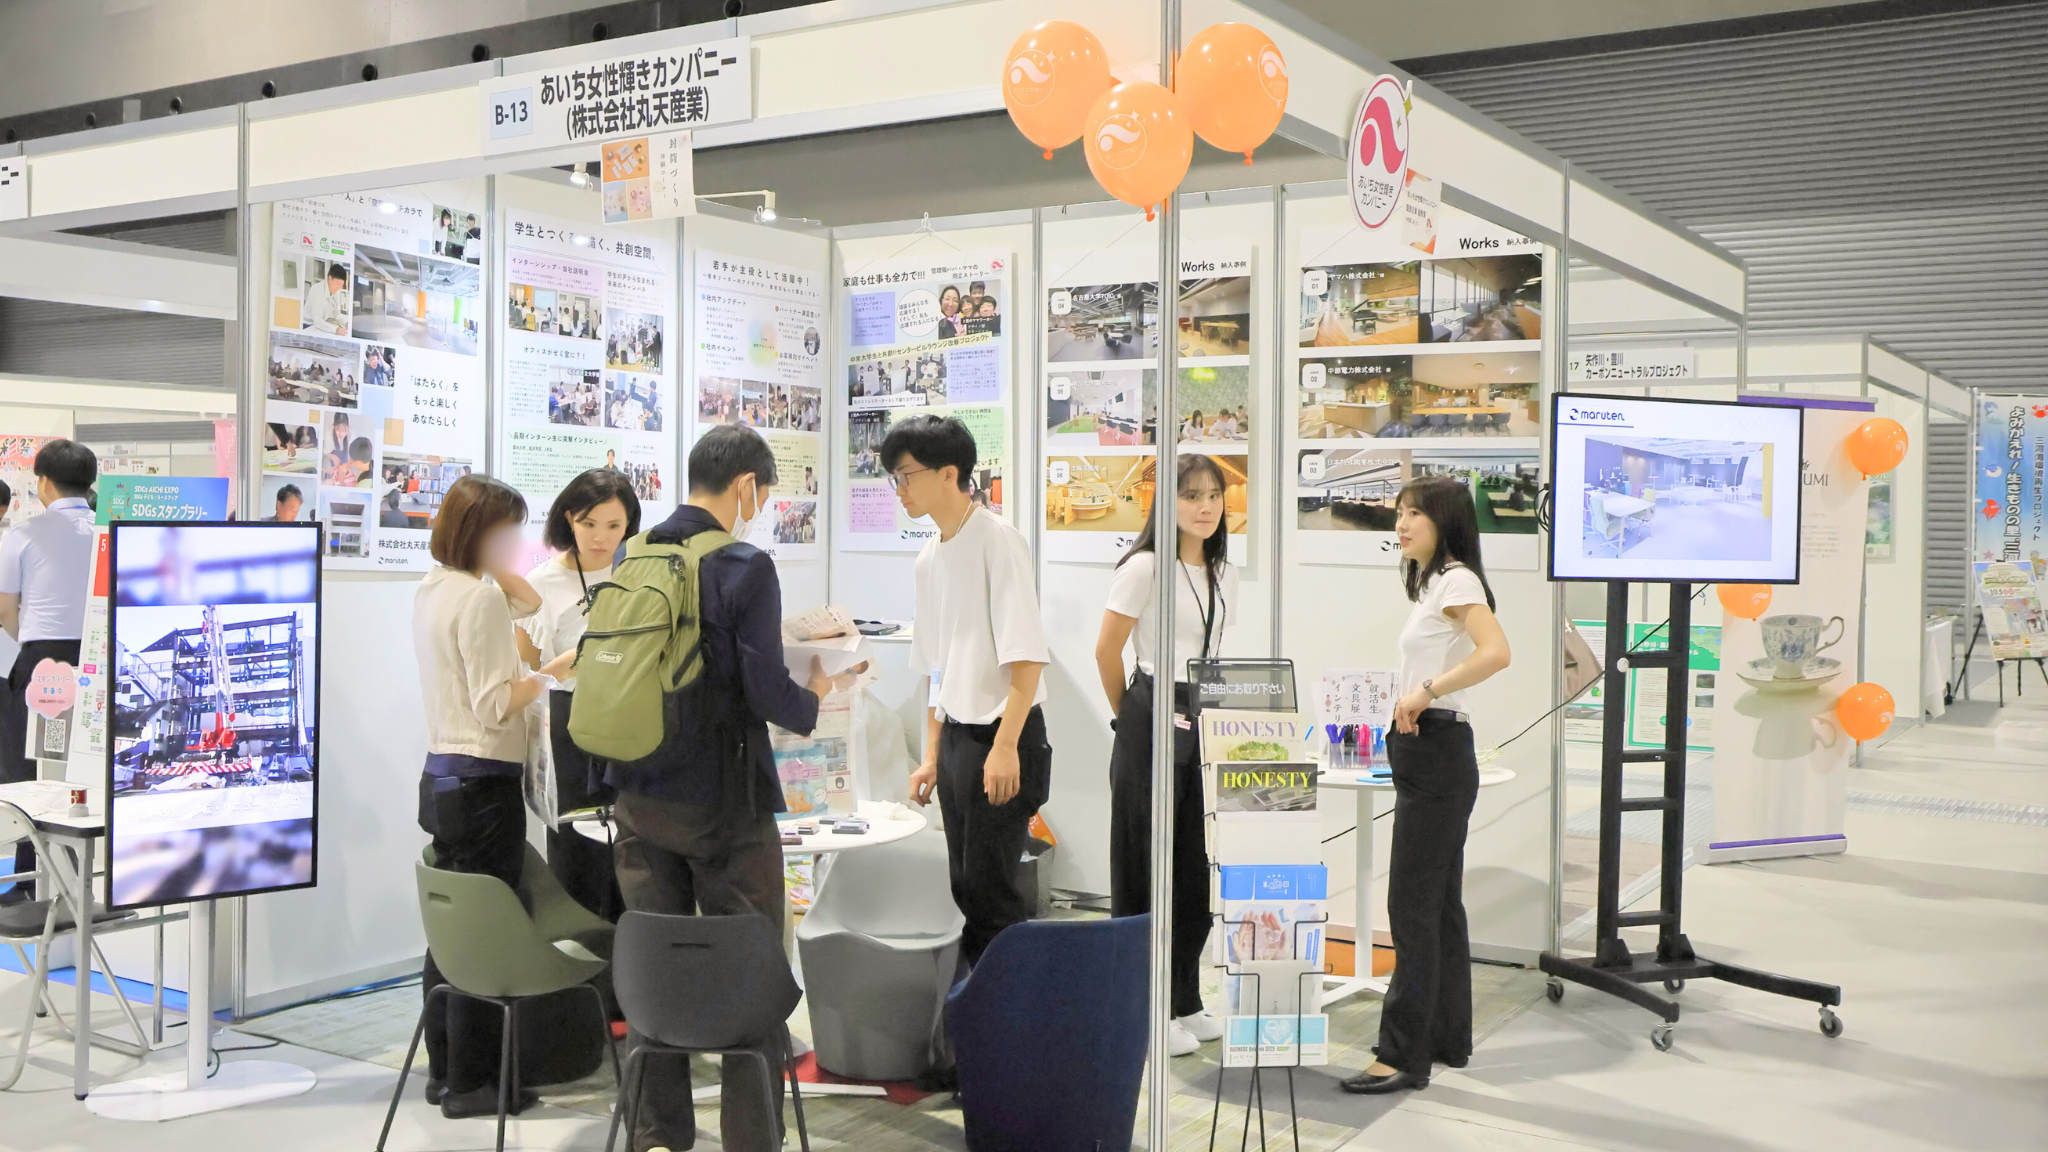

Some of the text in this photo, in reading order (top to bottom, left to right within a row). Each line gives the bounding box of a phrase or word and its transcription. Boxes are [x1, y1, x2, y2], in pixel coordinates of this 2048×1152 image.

[541, 47, 737, 106] あいち女性輝きカンパニー
[495, 100, 529, 126] B-13
[566, 86, 710, 140] (株式会社丸天産業)
[668, 138, 679, 208] 封筒づくり
[1358, 175, 1394, 198] あいち女性輝き
[1361, 193, 1387, 209] カンパニー
[1459, 237, 1537, 250] Works 納入事例
[1181, 260, 1247, 273] Works 納入事例
[1569, 362, 1579, 371] 17
[1585, 352, 1624, 366] 矢作川・豊川
[1328, 365, 1382, 375] 中部電力株式会社
[1585, 364, 1688, 379] カーボンニュートラルプロジェクト
[1310, 375, 1318, 383] 02
[413, 395, 458, 410] もっと楽しく
[412, 413, 457, 428] あなたらしく
[1580, 409, 1625, 421] maruten
[134, 485, 148, 493] SDGs
[164, 486, 179, 494] EXPO
[112, 497, 125, 506] SDGs
[132, 503, 208, 520] SDGsスタンプラリー
[101, 539, 107, 551] 5
[37, 675, 71, 684] スタンプラリー
[1200, 683, 1286, 695] ご自由にお取り下さい
[1333, 683, 1342, 727] インテリ
[1351, 683, 1361, 713] 文具展
[1369, 683, 1380, 714] 就活生
[1213, 720, 1299, 737] HONESTY
[1223, 772, 1312, 788] HONESTY
